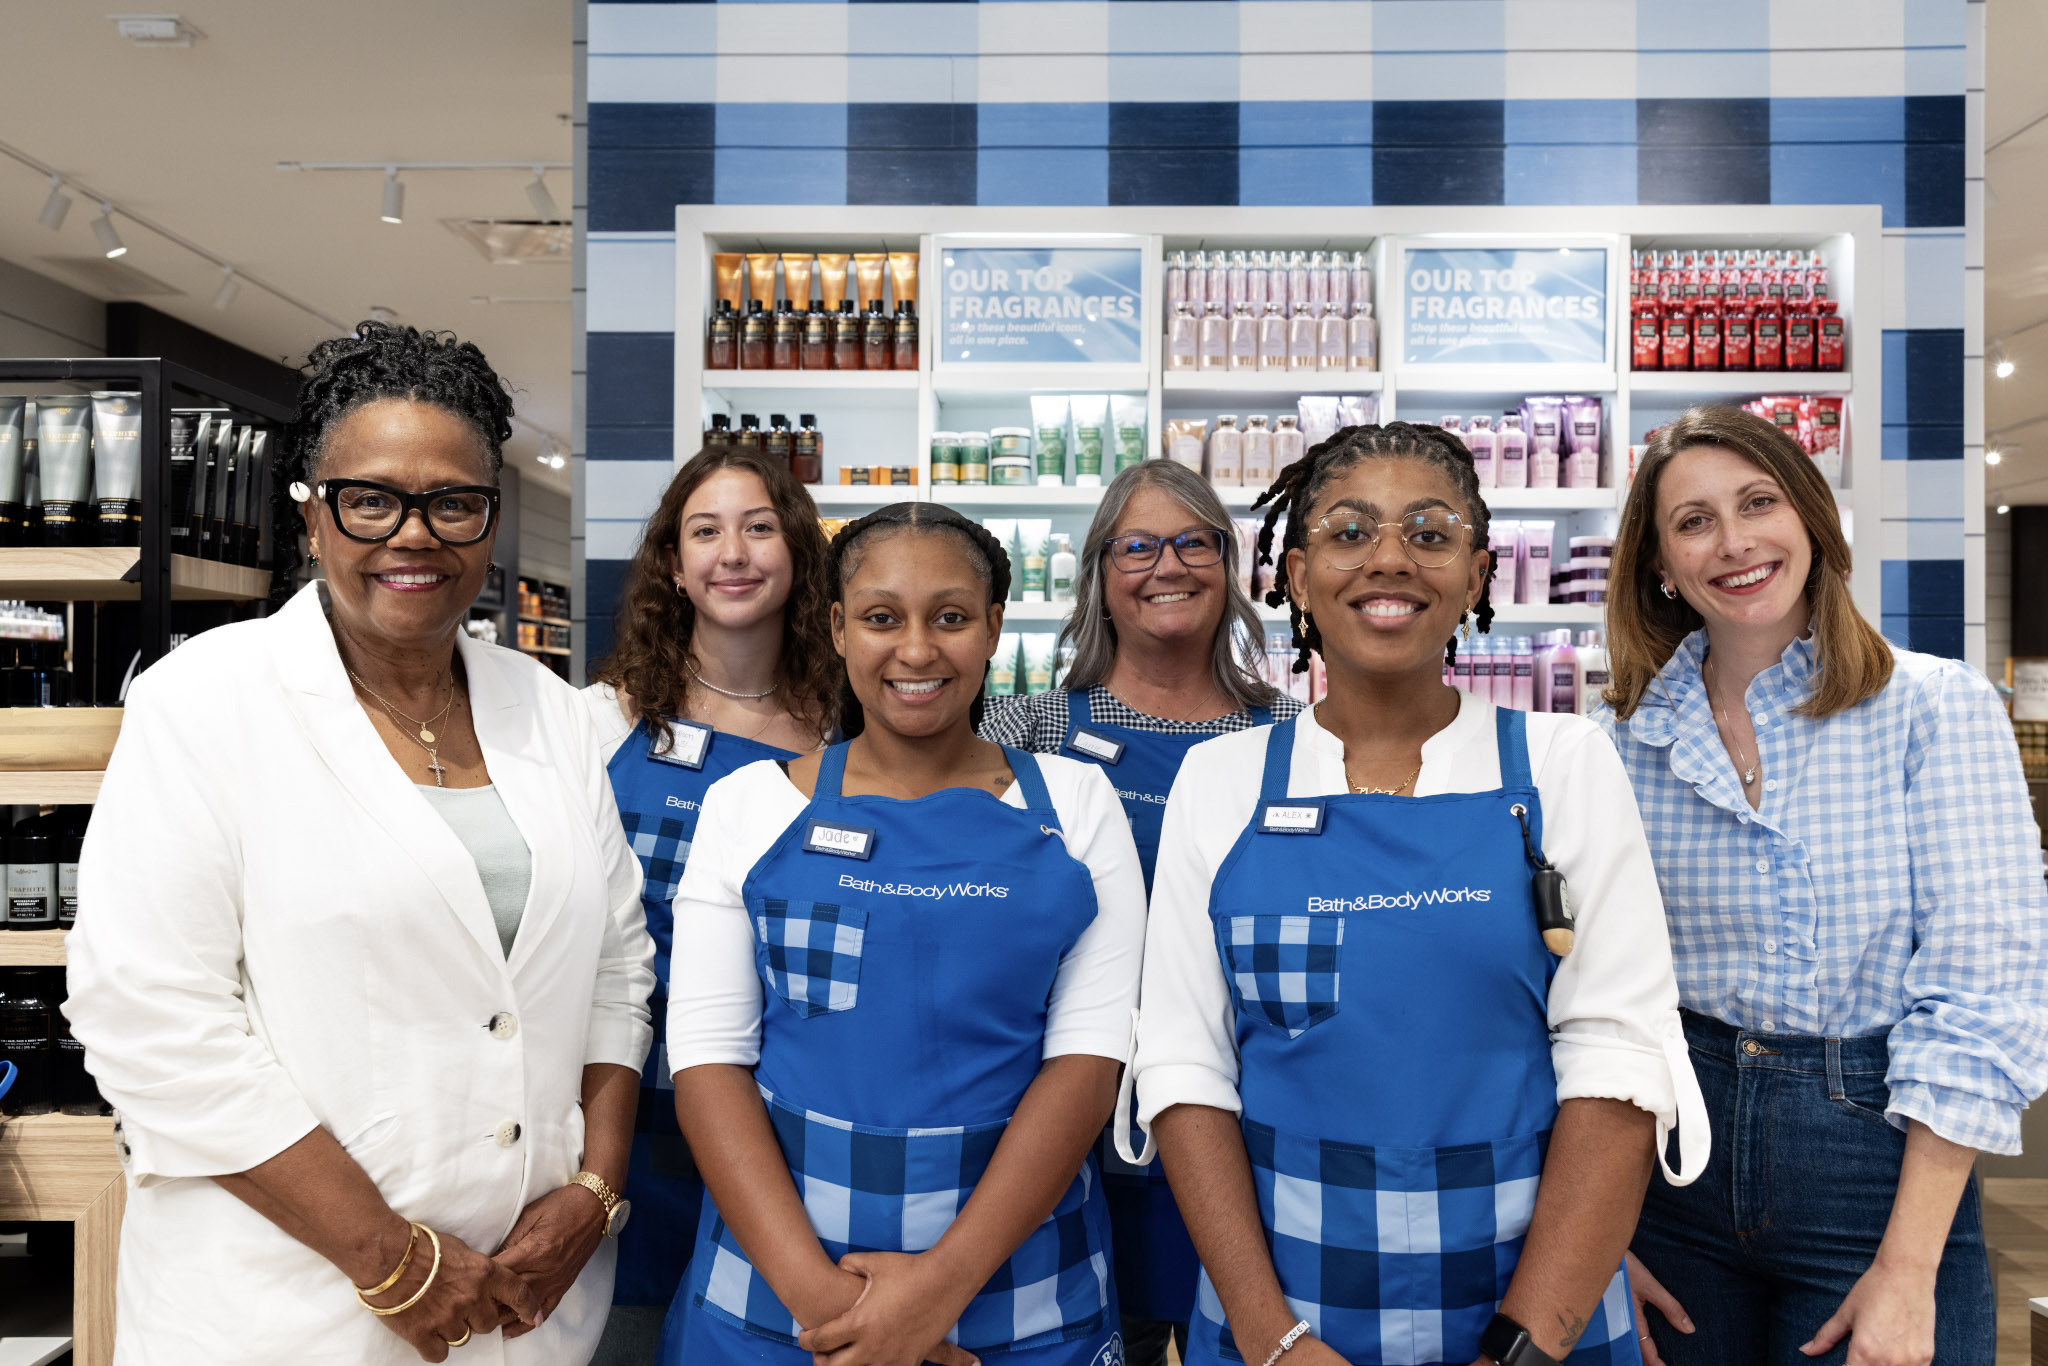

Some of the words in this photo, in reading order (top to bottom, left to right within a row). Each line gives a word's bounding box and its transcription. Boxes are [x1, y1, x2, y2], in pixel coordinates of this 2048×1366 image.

[949, 269, 1009, 292] OUR
[1016, 269, 1074, 292] TOP
[1411, 269, 1472, 292] OUR
[1480, 269, 1537, 292] TOP
[950, 296, 1135, 319] FRAGRANCES
[1411, 296, 1599, 319] FRAGRANCES
[978, 323, 1006, 332] these
[1008, 323, 1055, 332] beautiful
[1410, 322, 1437, 334] Shop
[949, 336, 963, 345] all
[977, 337, 996, 345] one
[998, 336, 1029, 347] place.
[665, 796, 701, 812] Bath
[1282, 811, 1303, 819] ALEX
[818, 829, 850, 844] Jade
